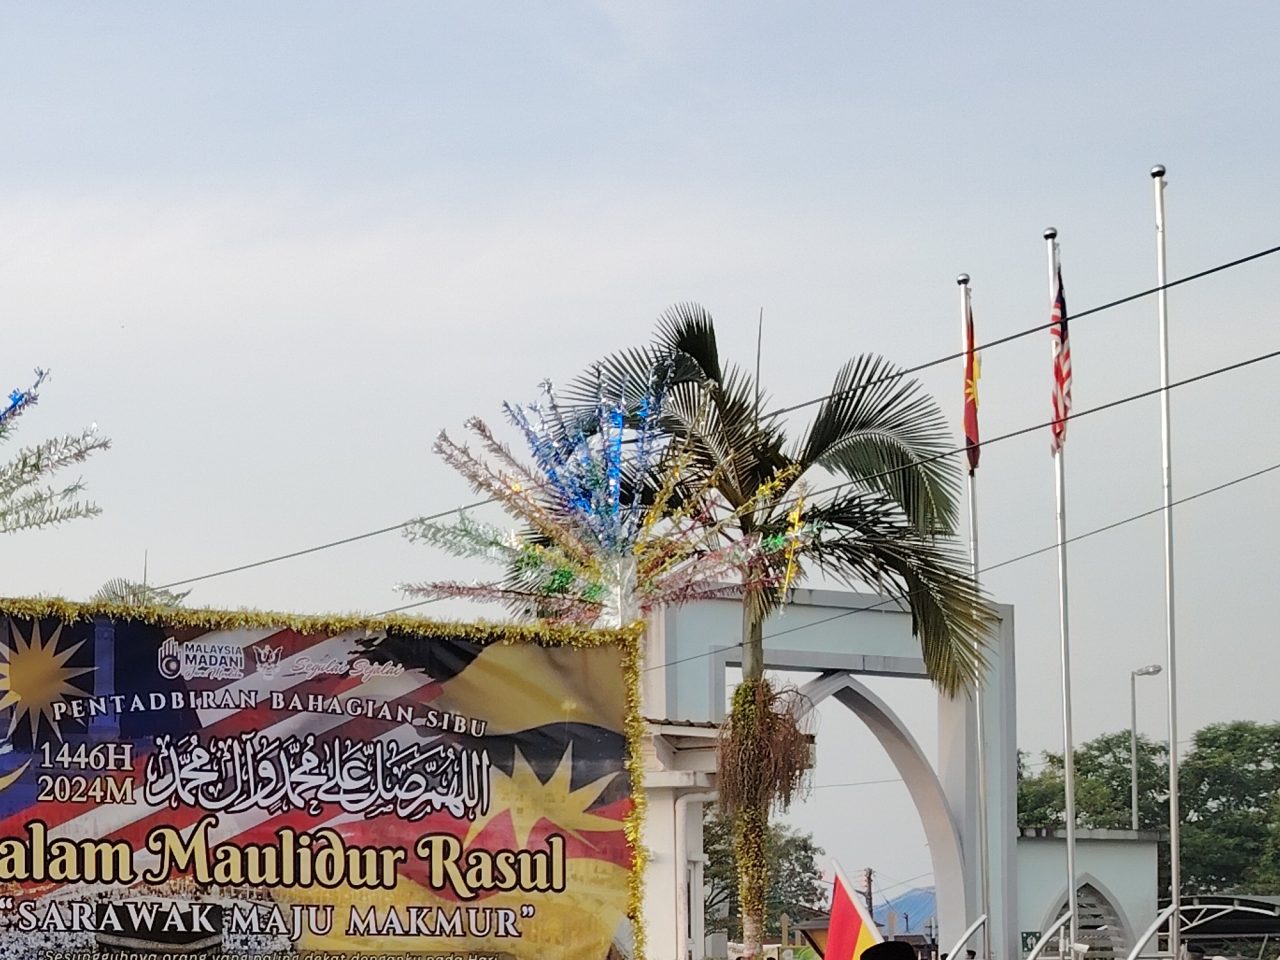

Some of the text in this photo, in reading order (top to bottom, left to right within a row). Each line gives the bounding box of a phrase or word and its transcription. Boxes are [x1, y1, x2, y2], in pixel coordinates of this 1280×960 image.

[184, 643, 243, 656] MALAYSIA
[184, 653, 244, 669] MADANI
[53, 690, 487, 737] PENTADBIRAN BAHAGIAN SIBU
[39, 742, 134, 771] 1446H
[37, 775, 136, 804] 2024M
[144, 816, 406, 888] Maulidur
[417, 834, 566, 899] Rasul
[230, 903, 335, 941] MAJU
[346, 904, 535, 938] MAKMUR”
